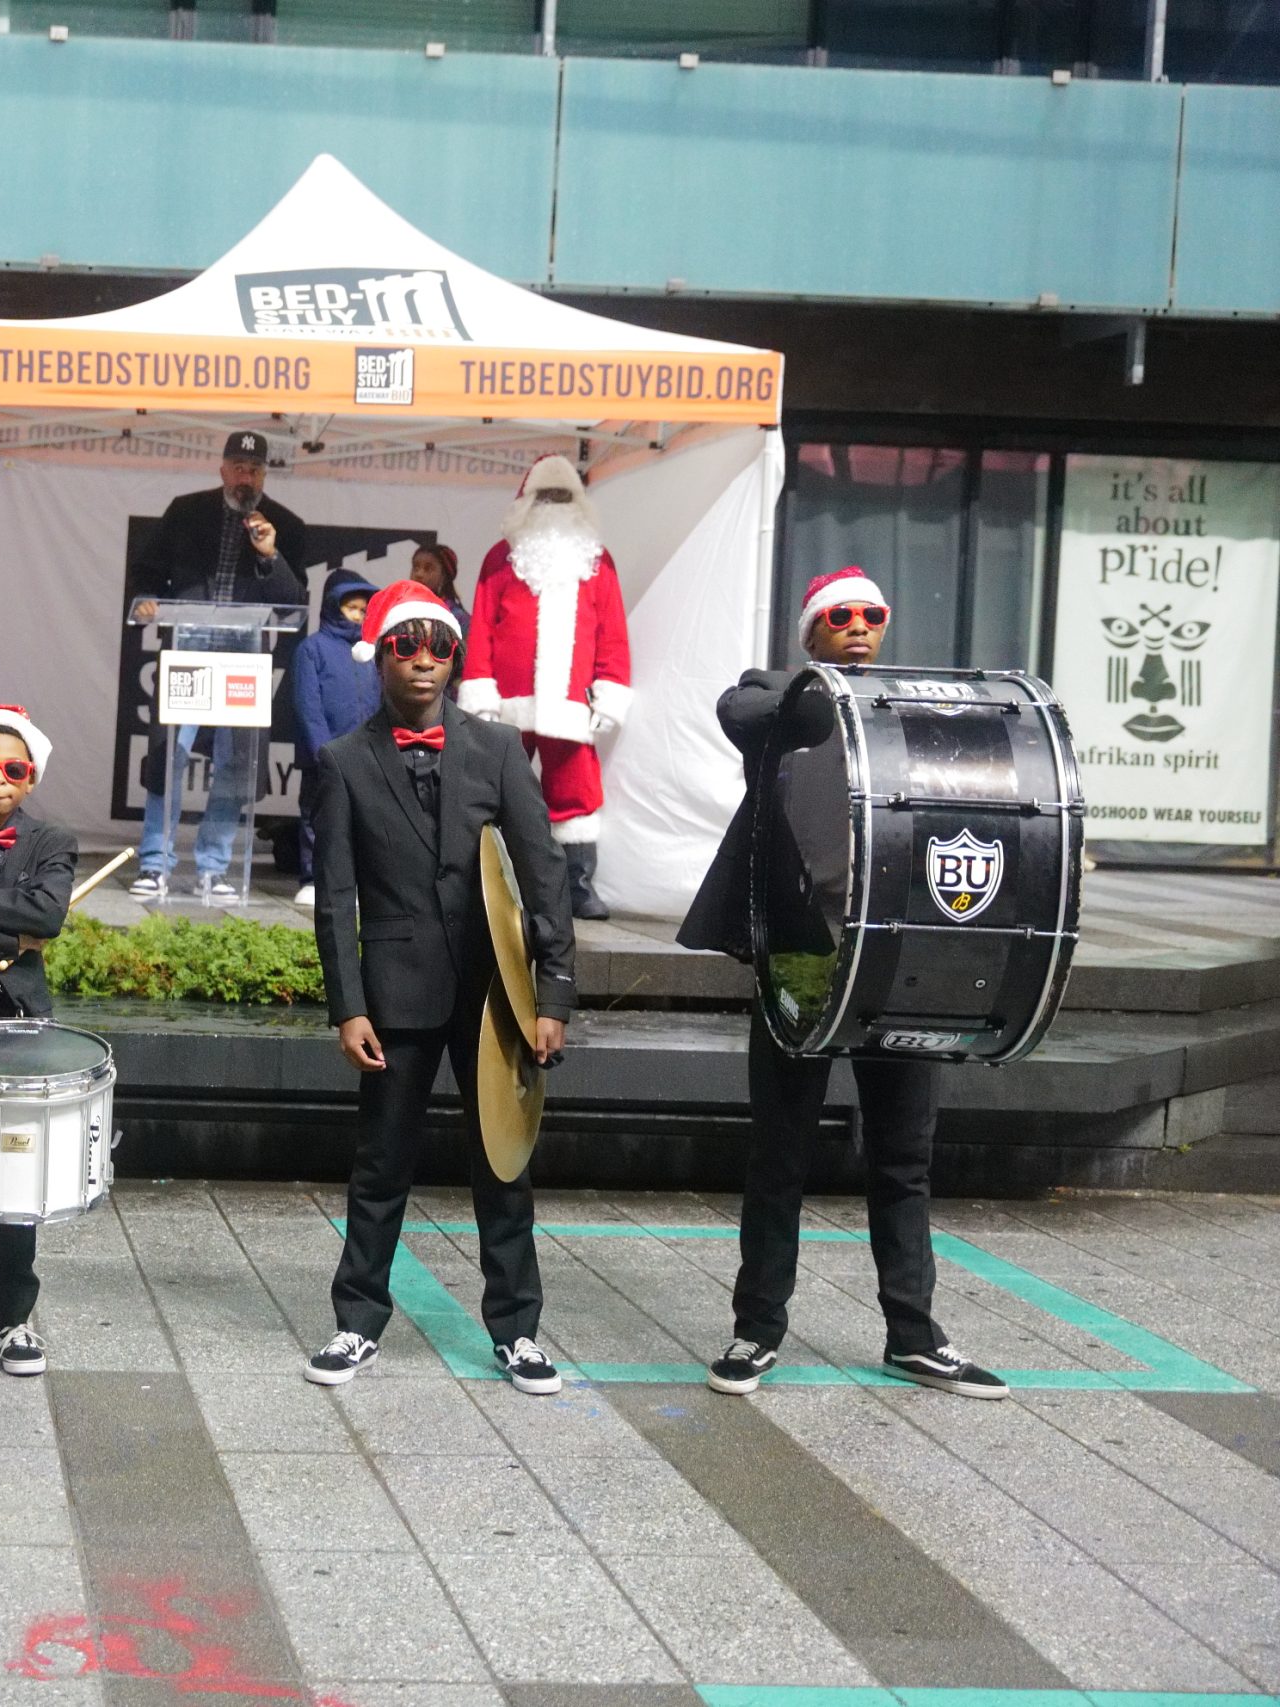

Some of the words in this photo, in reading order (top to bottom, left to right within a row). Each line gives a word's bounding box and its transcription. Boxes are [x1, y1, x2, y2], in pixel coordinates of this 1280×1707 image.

[254, 309, 358, 325] STUY
[357, 373, 388, 387] STUY
[459, 360, 774, 401] THEBEDSTUYBID.ORG
[1111, 471, 1158, 501] it's
[1167, 474, 1207, 505] all
[1116, 506, 1208, 537] about
[1099, 544, 1223, 593] pride!
[170, 686, 193, 697] STUY
[227, 682, 254, 690] WELLS
[227, 690, 255, 698] FARGO
[1078, 747, 1156, 768] afrikan
[1163, 750, 1219, 773] spirit
[1153, 807, 1193, 821] WEAR
[1198, 809, 1262, 824] YOURSELF
[936, 854, 996, 890] BU
